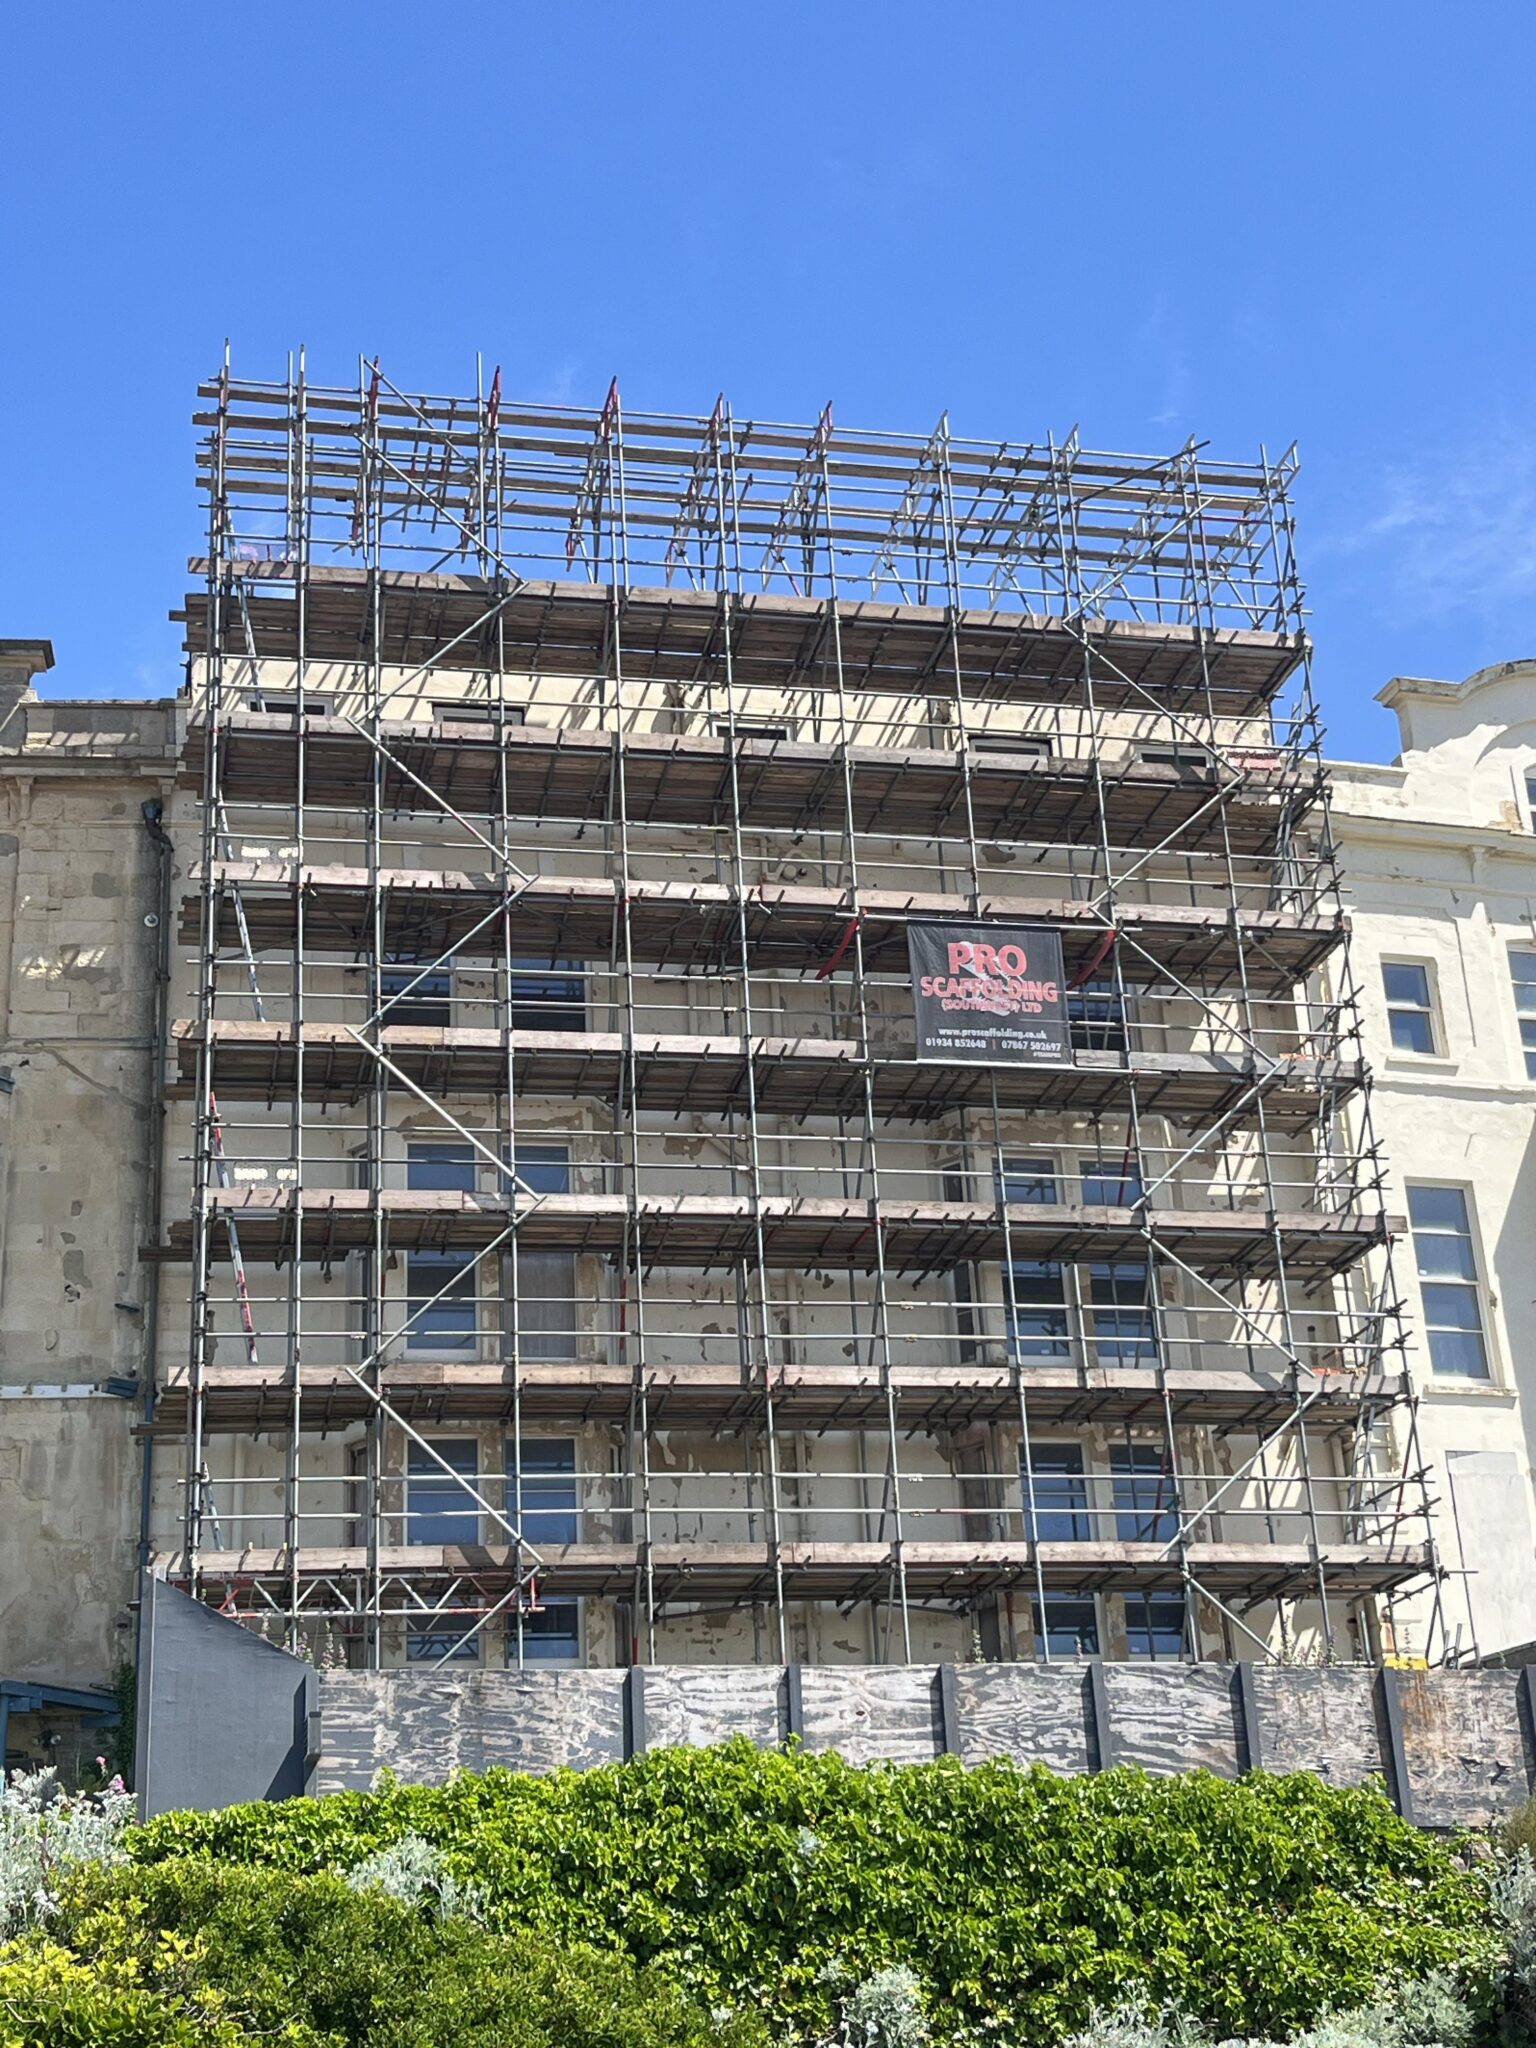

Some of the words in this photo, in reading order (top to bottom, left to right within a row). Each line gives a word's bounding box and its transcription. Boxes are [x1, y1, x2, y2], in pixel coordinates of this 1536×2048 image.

[947, 942, 1028, 977] PRO
[920, 976, 1058, 1002] SCAFFOLDING
[1021, 1001, 1043, 1014] LTD
[938, 1028, 1047, 1040] www.proscaffolding.co.uk
[925, 1037, 953, 1047] 01934
